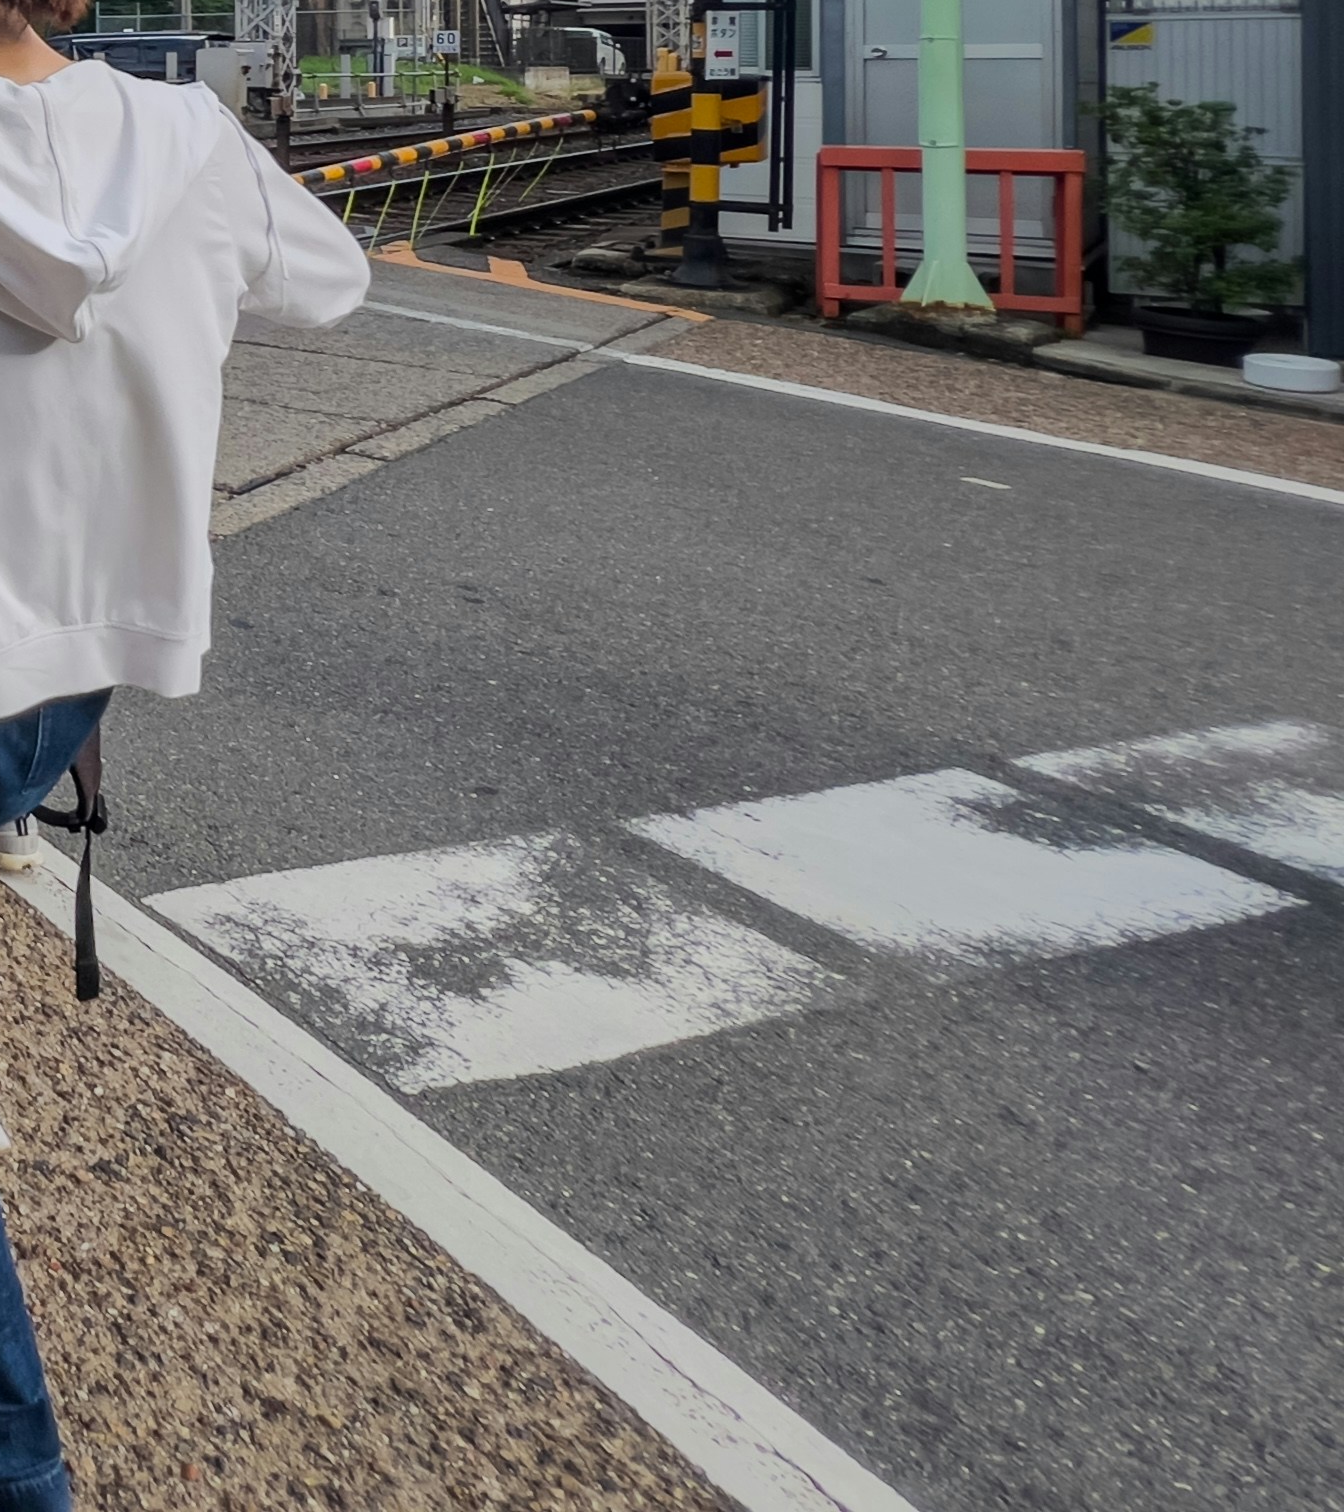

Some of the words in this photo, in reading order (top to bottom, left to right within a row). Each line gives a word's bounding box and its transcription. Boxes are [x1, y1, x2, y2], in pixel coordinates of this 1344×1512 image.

[436, 32, 456, 44] 60
[711, 28, 736, 38] ボタン
